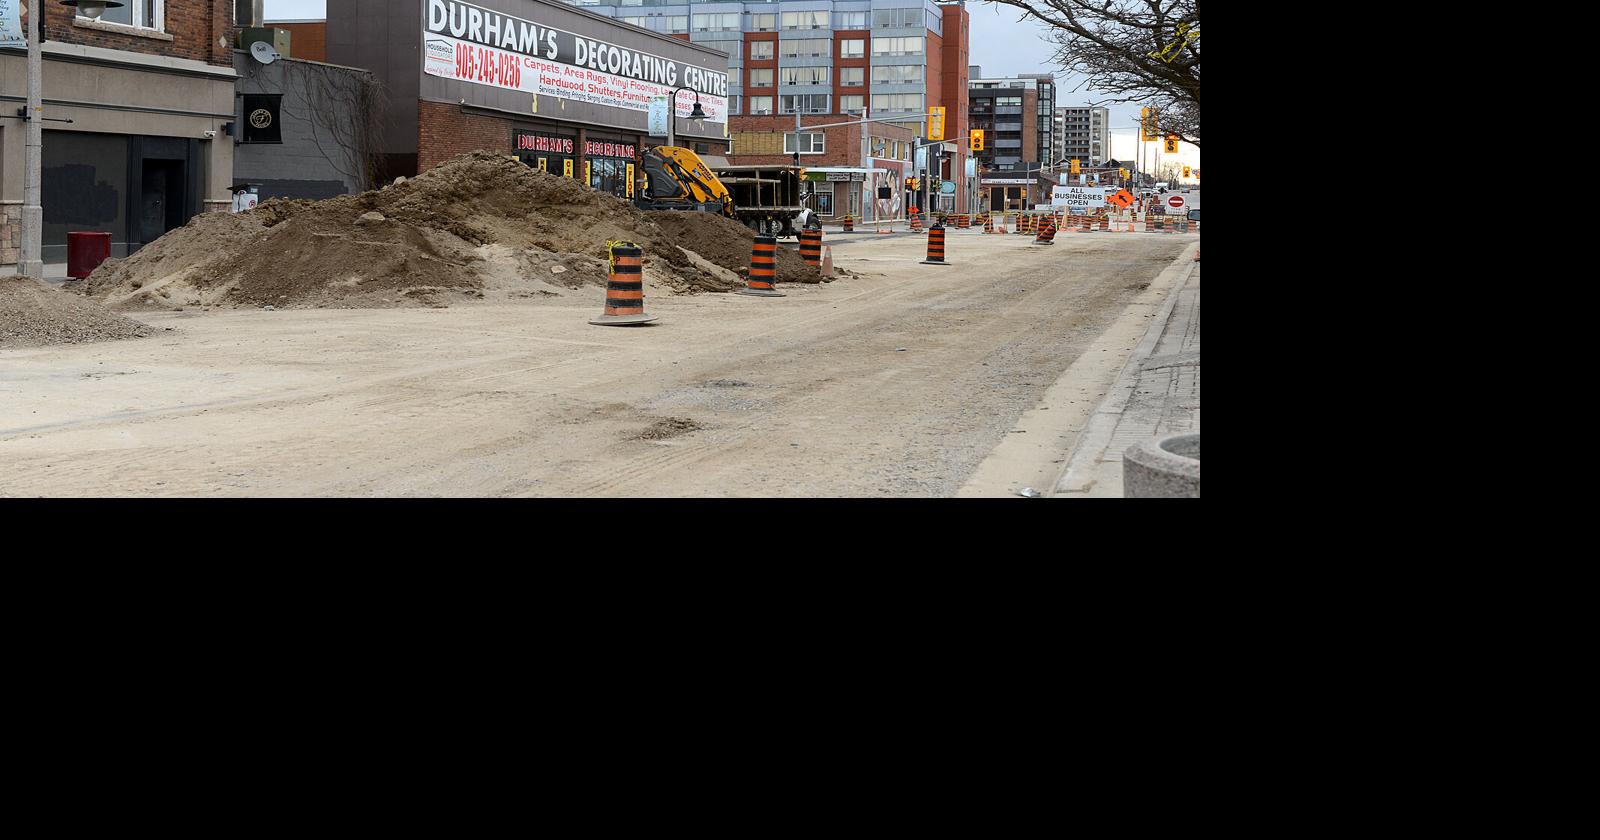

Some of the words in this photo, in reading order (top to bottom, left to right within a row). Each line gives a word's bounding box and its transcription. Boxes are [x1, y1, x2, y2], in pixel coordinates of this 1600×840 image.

[428, 0, 558, 60] DURHAM'S
[575, 37, 677, 87] DECORATING
[684, 66, 727, 96] CENTRE
[455, 42, 521, 89] 905-245-0256
[523, 57, 562, 75] Carpets,
[564, 66, 585, 80] Area
[586, 71, 609, 85] Rugs,
[610, 75, 629, 90] Vinyl
[630, 80, 660, 96] Flooring,
[539, 73, 587, 93] Hardwood,
[517, 134, 573, 154] DURHAM'S
[1054, 193, 1103, 201] BUSINESSES
